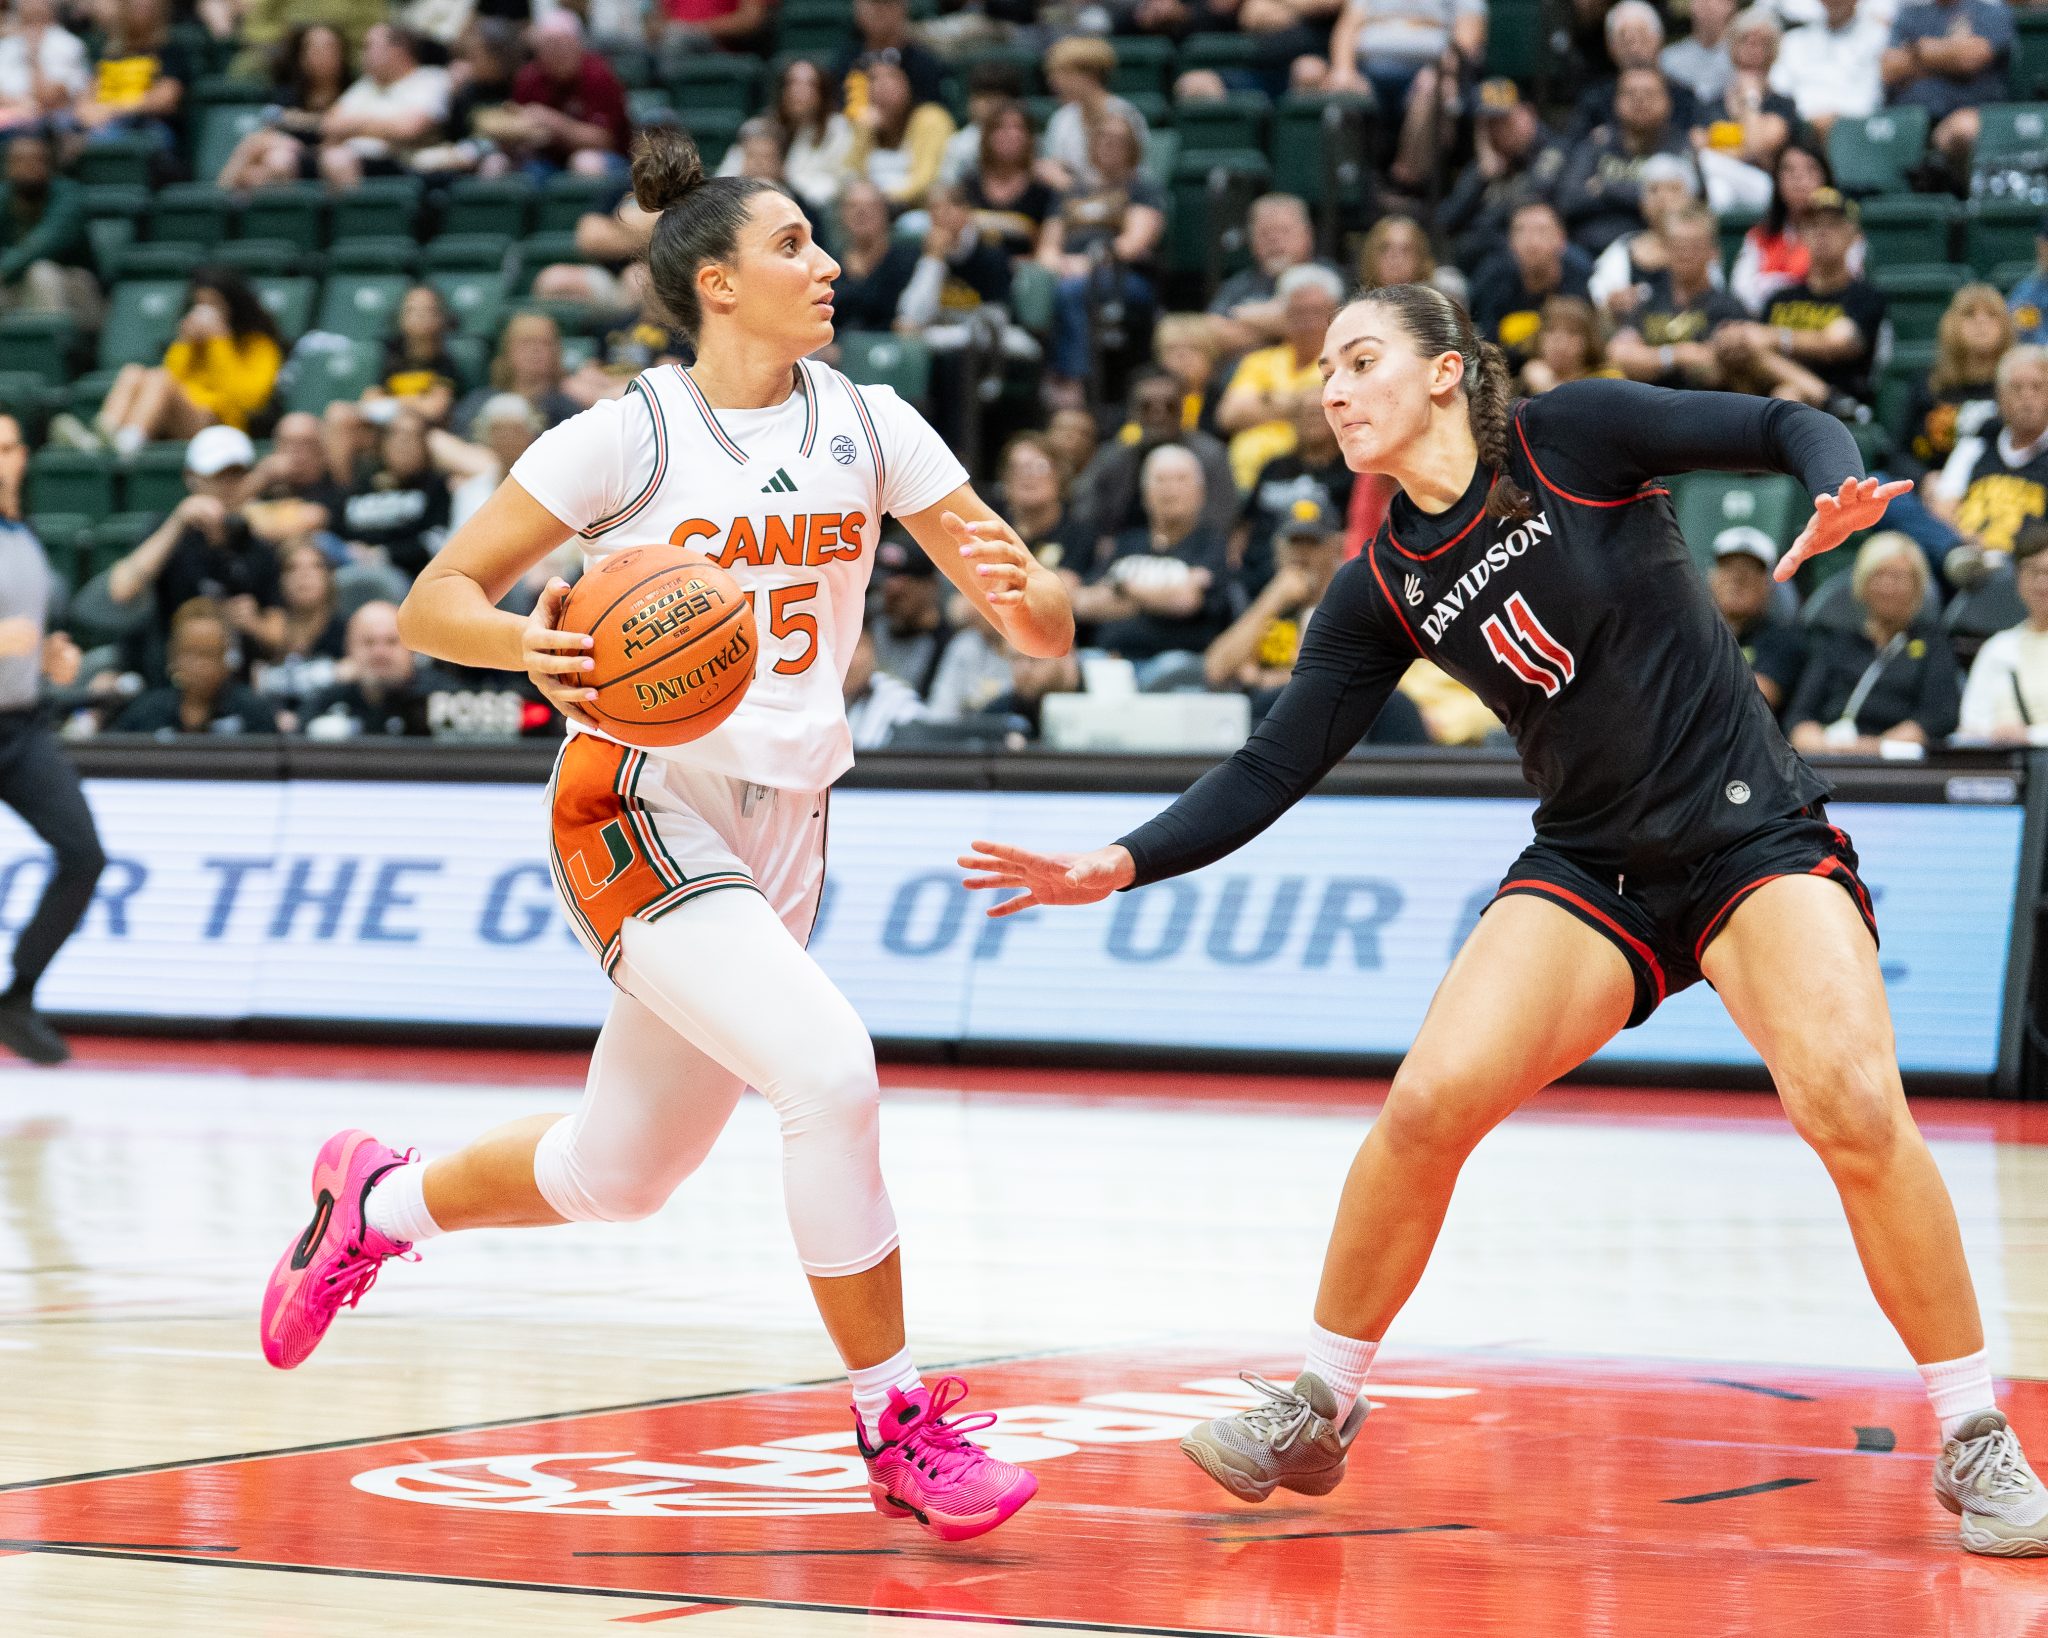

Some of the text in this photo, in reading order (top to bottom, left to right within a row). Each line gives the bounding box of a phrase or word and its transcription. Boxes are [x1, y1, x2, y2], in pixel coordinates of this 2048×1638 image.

[833, 444, 855, 452] ACC
[669, 511, 866, 569] CANES
[1420, 511, 1552, 645] DAVIDSON
[622, 588, 686, 633] 1000
[623, 588, 725, 659] LEGACY
[742, 581, 818, 681] 5
[1480, 590, 1576, 699] 11
[634, 623, 750, 711] SPALDING
[202, 856, 442, 940] THE
[1106, 875, 1406, 970] OUR
